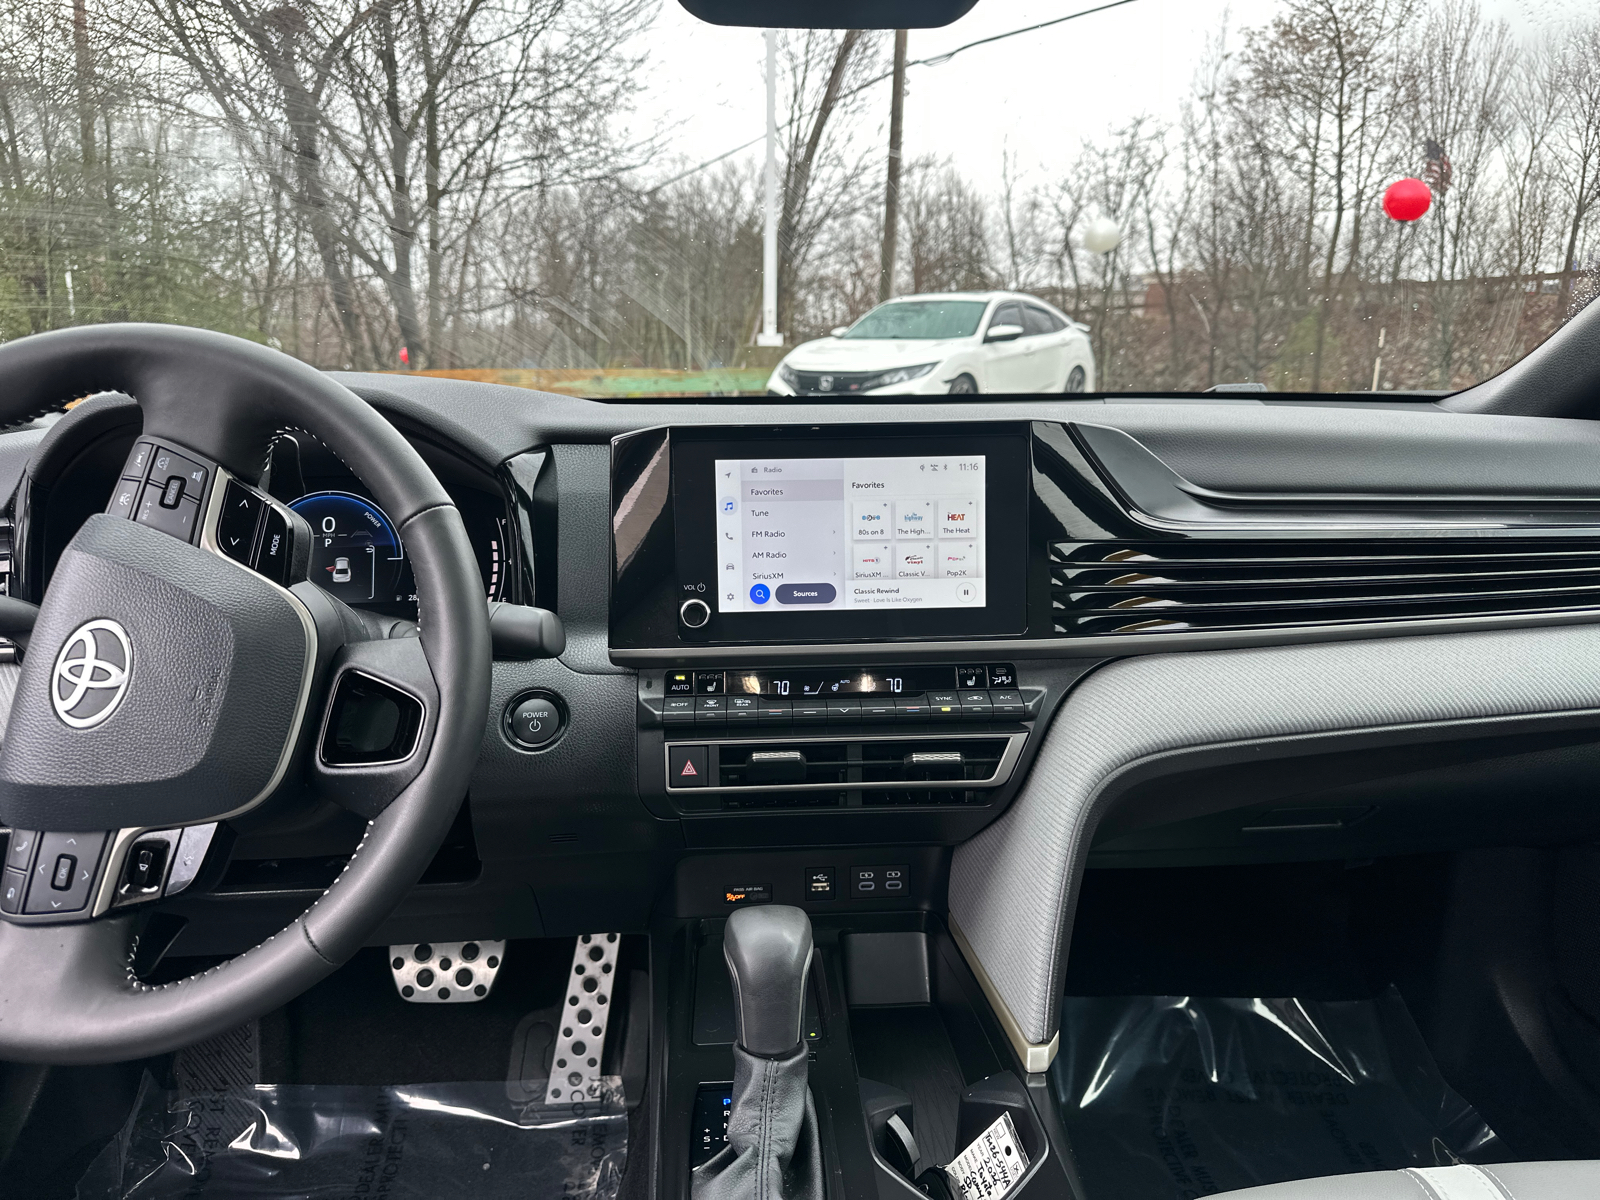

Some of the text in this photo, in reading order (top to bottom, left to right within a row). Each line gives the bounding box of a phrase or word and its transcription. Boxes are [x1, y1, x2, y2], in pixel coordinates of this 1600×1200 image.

[959, 463, 978, 471] 11:16
[322, 516, 336, 532] 0
[364, 512, 382, 528] POWER
[270, 534, 281, 556] MODE
[324, 538, 332, 548] P
[773, 680, 790, 696] 70
[886, 678, 902, 692] 70
[58, 866, 68, 878] OK
[978, 1162, 992, 1196] Toyota
[983, 1158, 1001, 1186] 2026
[1190, 1166, 1218, 1192] MUS
